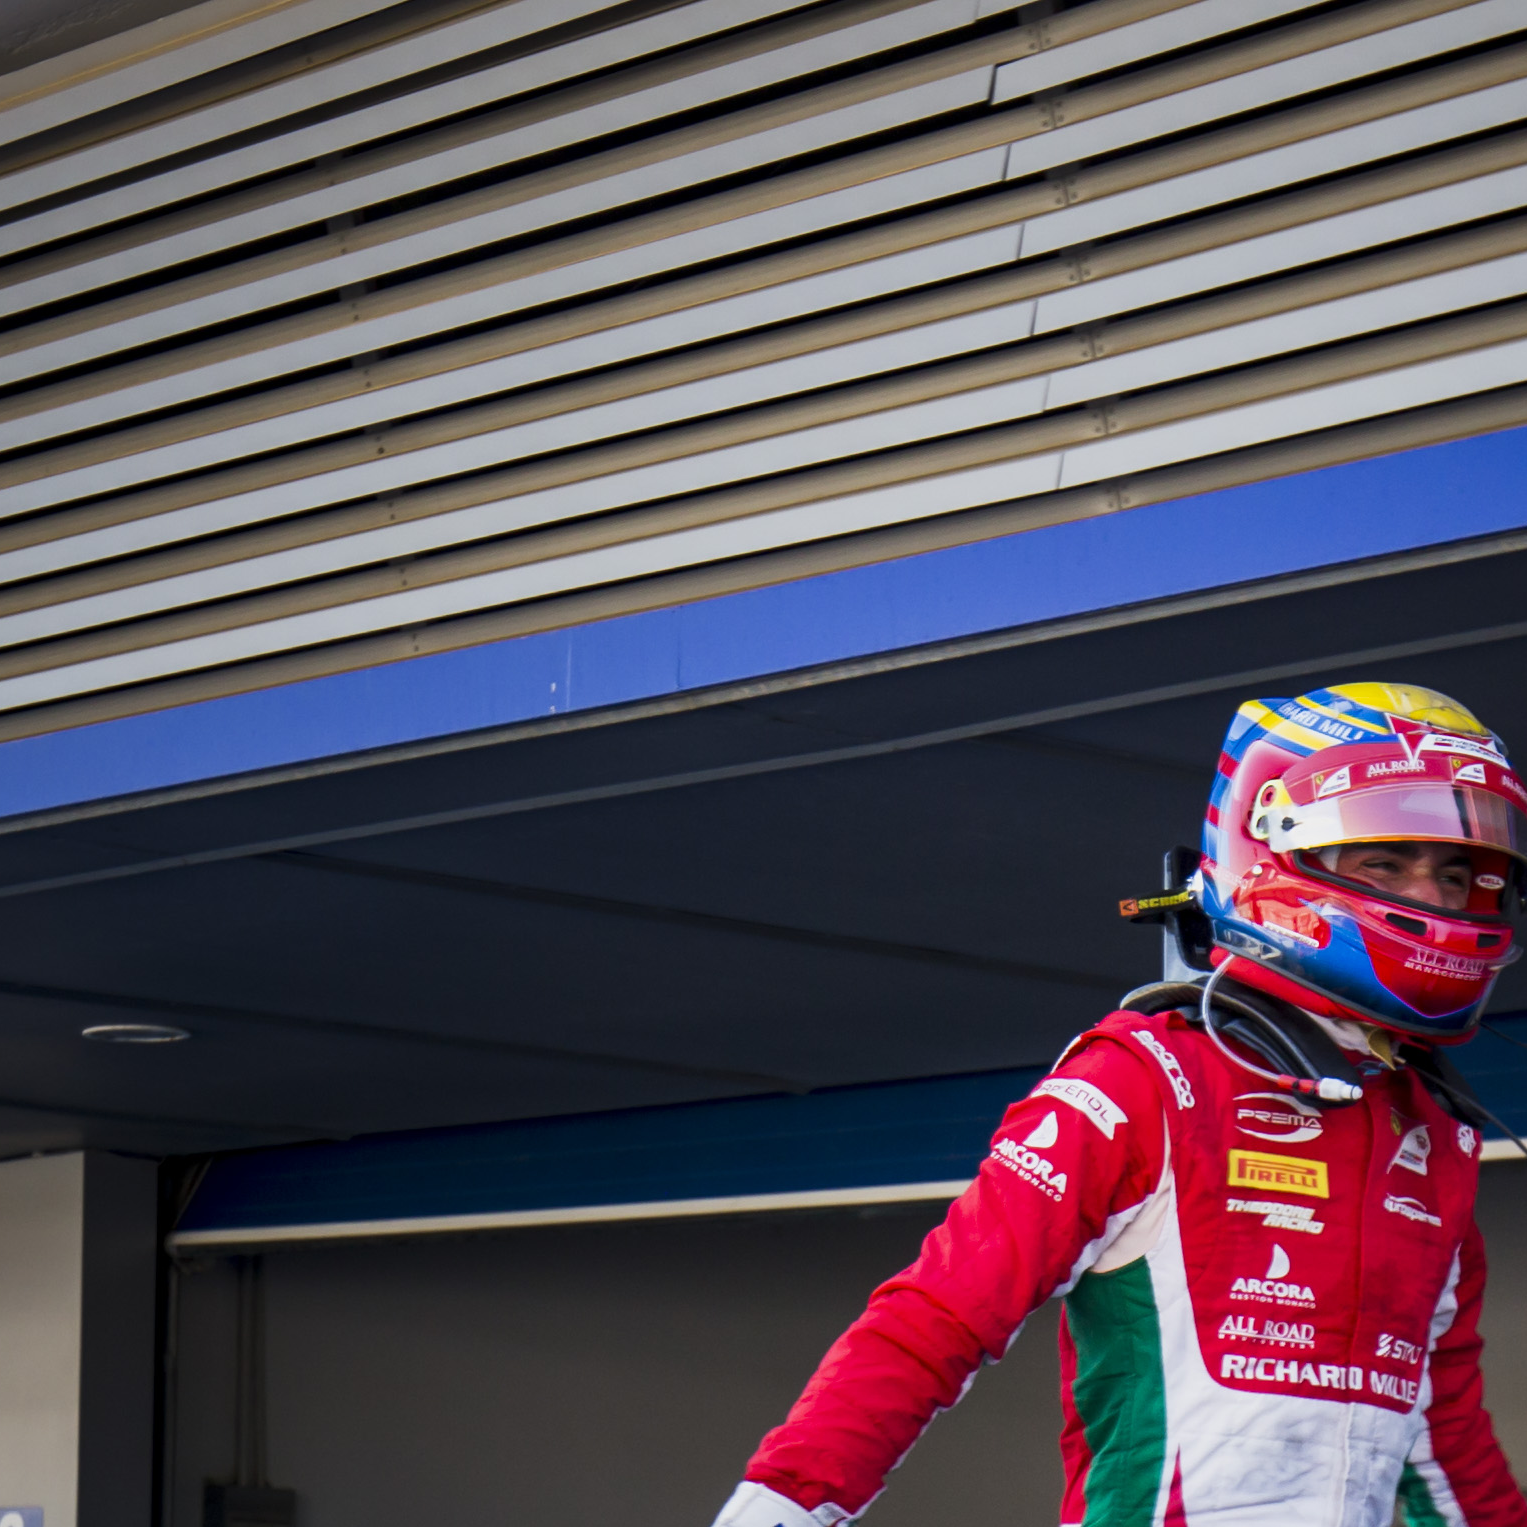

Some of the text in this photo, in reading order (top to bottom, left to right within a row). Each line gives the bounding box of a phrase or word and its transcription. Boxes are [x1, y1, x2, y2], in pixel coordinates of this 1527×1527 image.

[1237, 1108, 1322, 1129] PREMA
[992, 1137, 1068, 1194] ARCORA
[1237, 1158, 1319, 1188] PIRELLI
[1231, 1277, 1316, 1301] ARCORA
[1220, 1314, 1316, 1341] ALL ROAD
[1221, 1354, 1363, 1391] RICHARD
